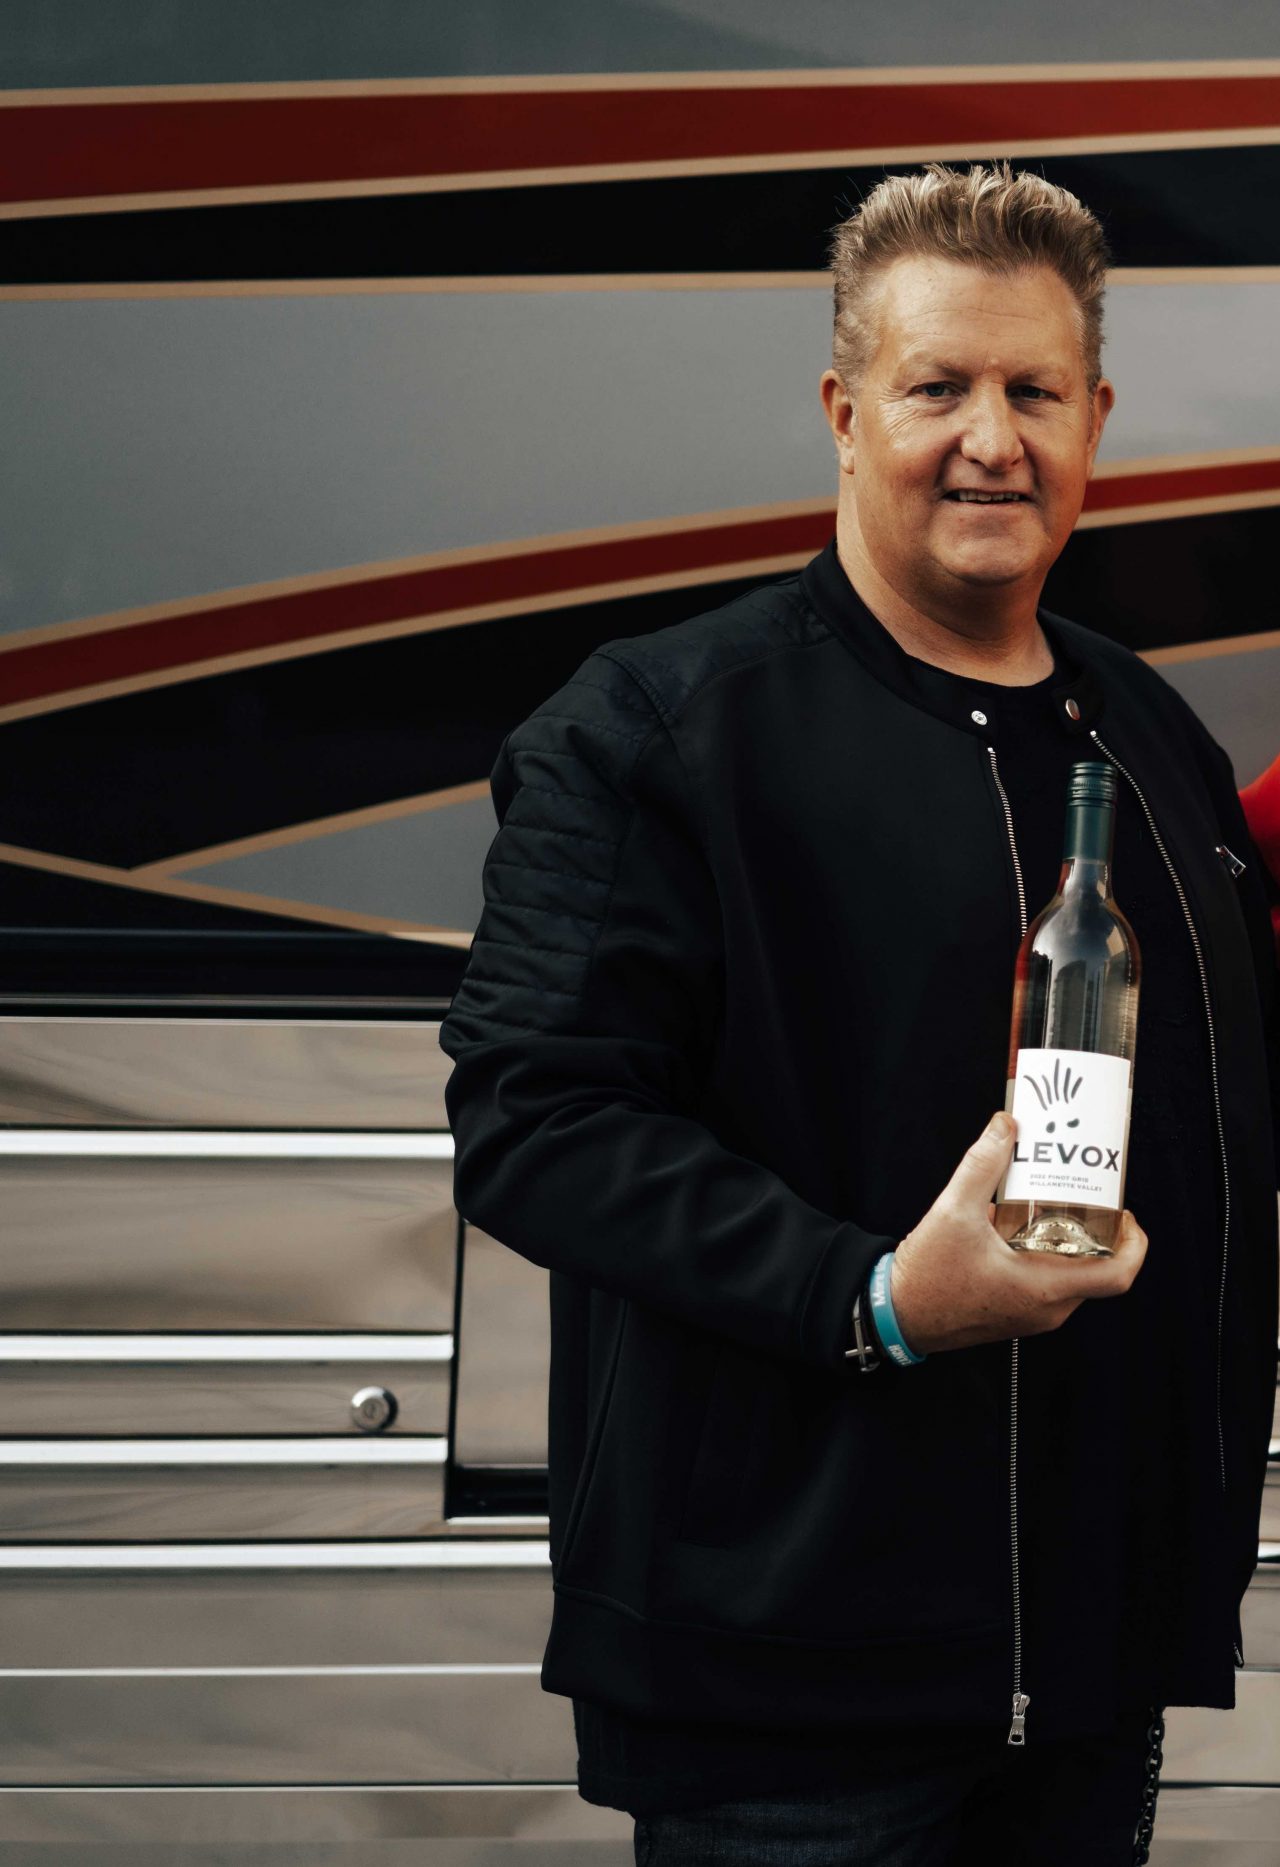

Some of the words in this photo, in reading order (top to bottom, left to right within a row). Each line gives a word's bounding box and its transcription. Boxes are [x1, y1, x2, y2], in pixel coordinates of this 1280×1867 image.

[1013, 1141, 1120, 1172] LEVOX
[1029, 1181, 1075, 1189] WILLAMETTE
[1077, 1184, 1103, 1192] VALLEY
